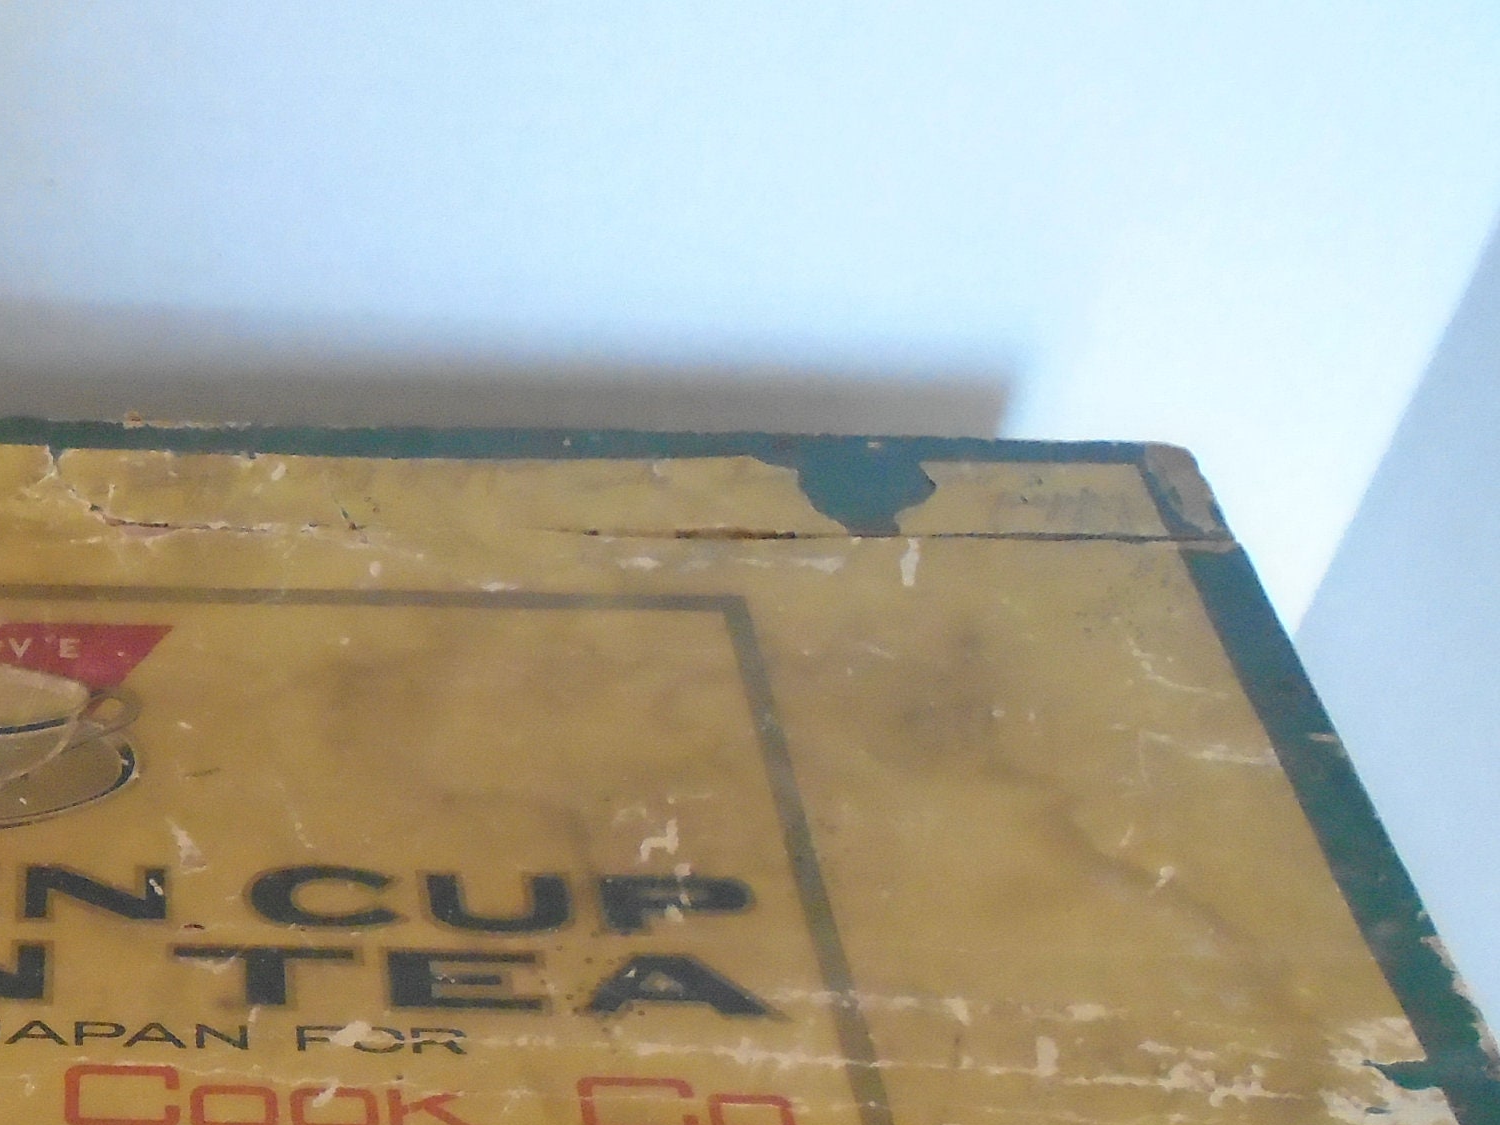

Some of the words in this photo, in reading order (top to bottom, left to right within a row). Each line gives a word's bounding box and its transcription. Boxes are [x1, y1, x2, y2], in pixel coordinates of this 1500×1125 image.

[247, 864, 754, 932] CUP
[172, 943, 784, 1018] TEA
[296, 1024, 468, 1055] FOR
